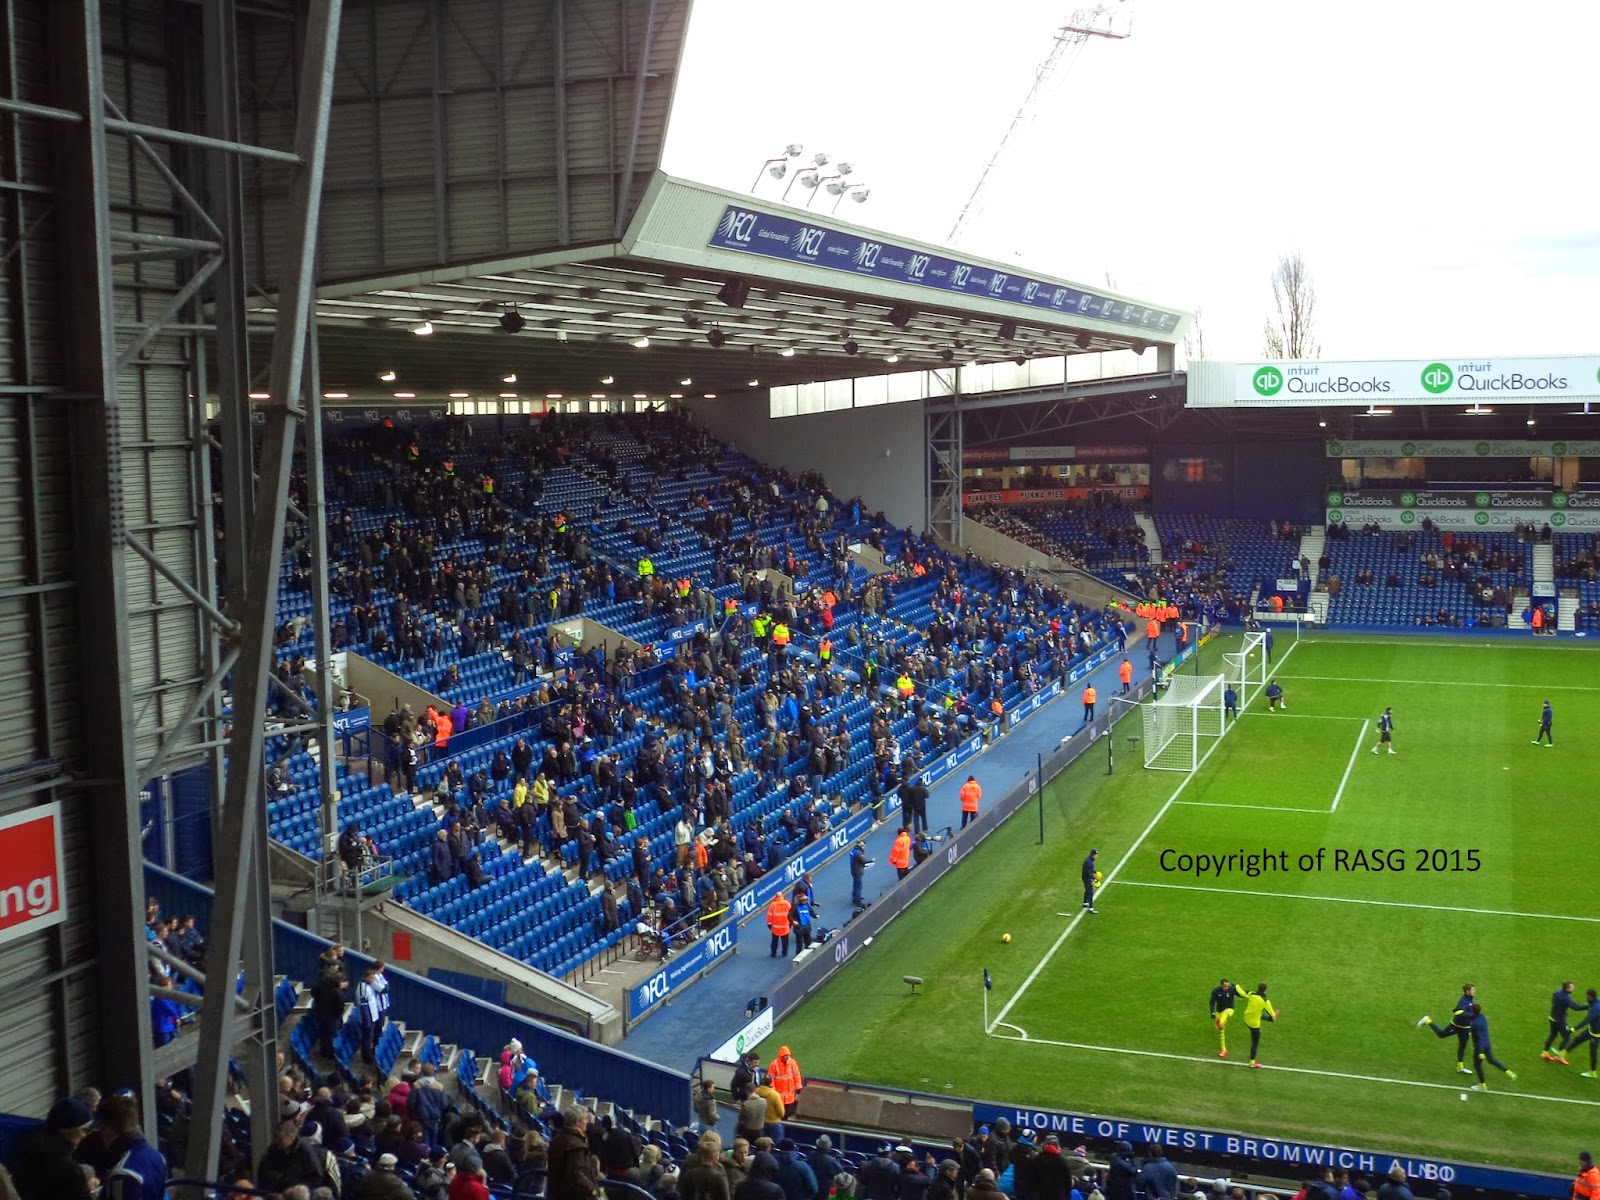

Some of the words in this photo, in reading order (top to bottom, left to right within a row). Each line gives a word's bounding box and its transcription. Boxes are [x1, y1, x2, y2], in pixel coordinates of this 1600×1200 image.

[728, 212, 758, 242] FCL
[800, 228, 826, 256] FCL
[859, 243, 882, 268] FCL
[910, 256, 931, 278] FCL
[954, 266, 972, 286] FCL
[1288, 367, 1320, 376] intuit
[1458, 362, 1492, 373] intuit
[1287, 377, 1391, 395] QuickBooks
[1457, 373, 1568, 392] QuickBooks
[1344, 497, 1393, 506] QuickBooks
[1417, 498, 1467, 506] QuickBooks
[1491, 498, 1543, 506] QuickBooks
[1344, 515, 1392, 523] QuickBooks
[1491, 517, 1542, 525] QuickBooks
[835, 827, 848, 850] FCL
[791, 856, 806, 881] FCL
[0, 875, 52, 918] ng
[740, 889, 757, 916] FCL
[834, 938, 849, 963] ON
[649, 971, 670, 1003] FCL
[714, 927, 732, 955] FCL
[1016, 1111, 1085, 1134] HOME
[1098, 1121, 1130, 1139] OF
[1143, 1126, 1214, 1150] WEST
[1226, 1138, 1374, 1172] BROMWICH
